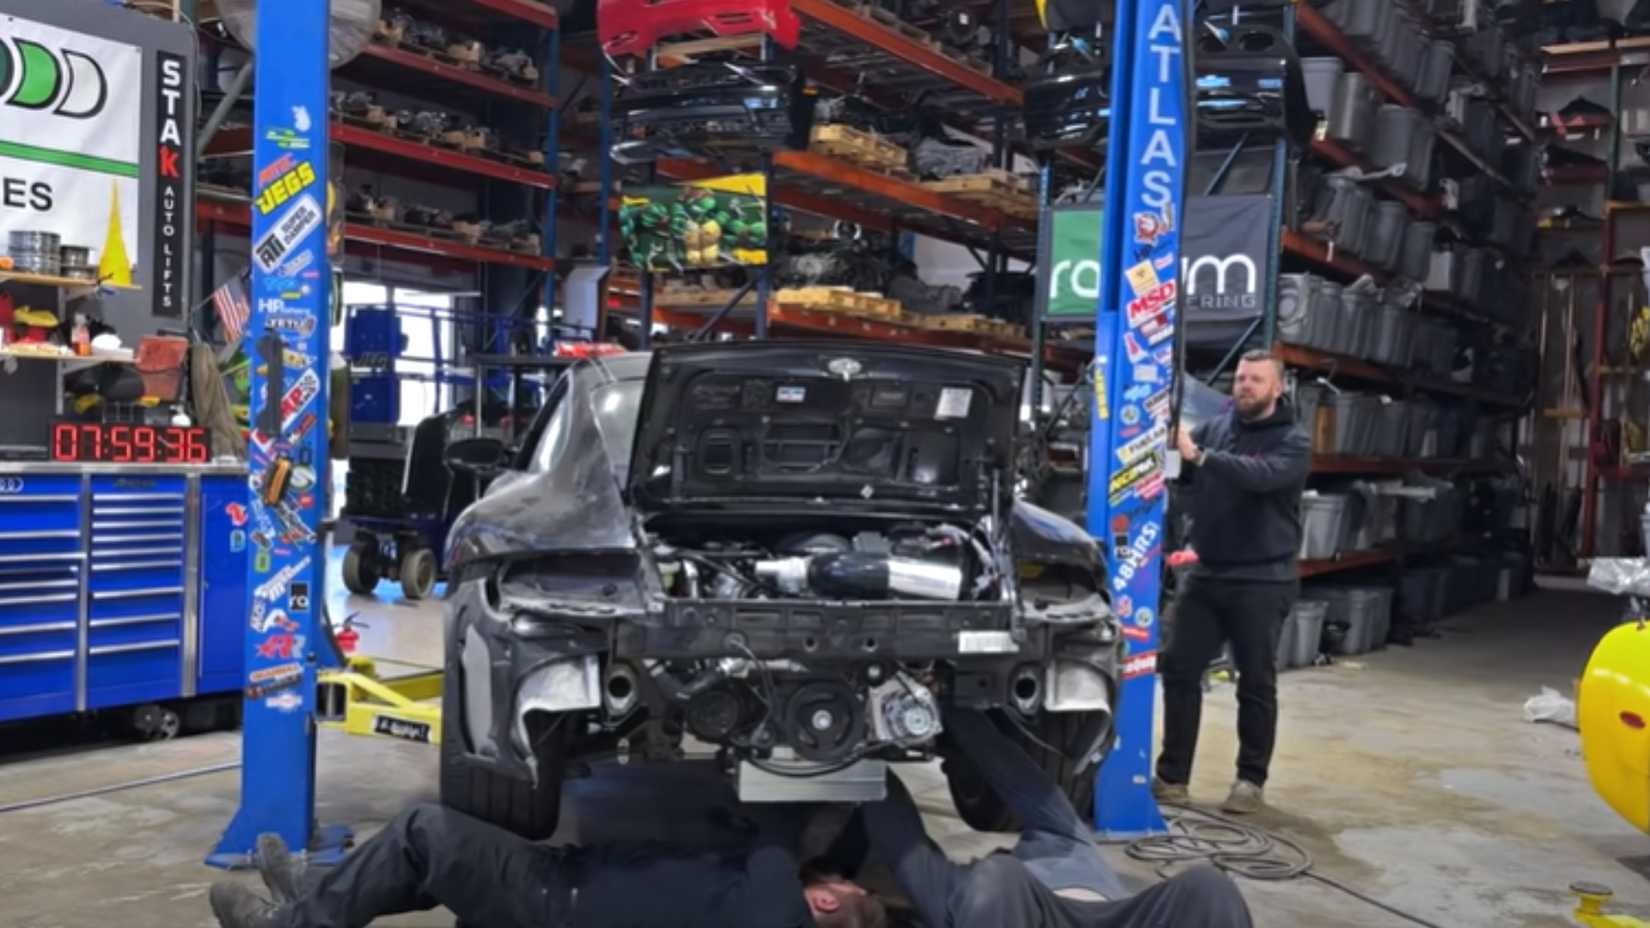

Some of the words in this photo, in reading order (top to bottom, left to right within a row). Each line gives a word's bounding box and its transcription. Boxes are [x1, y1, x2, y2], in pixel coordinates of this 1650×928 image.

[158, 60, 181, 178] STAK
[1140, 4, 1182, 208] ATLAS
[3, 178, 53, 211] ES
[163, 185, 176, 236] AUTO
[256, 162, 316, 215] JEGS
[162, 244, 173, 307] LIFTS
[55, 424, 207, 463] 07:59:36
